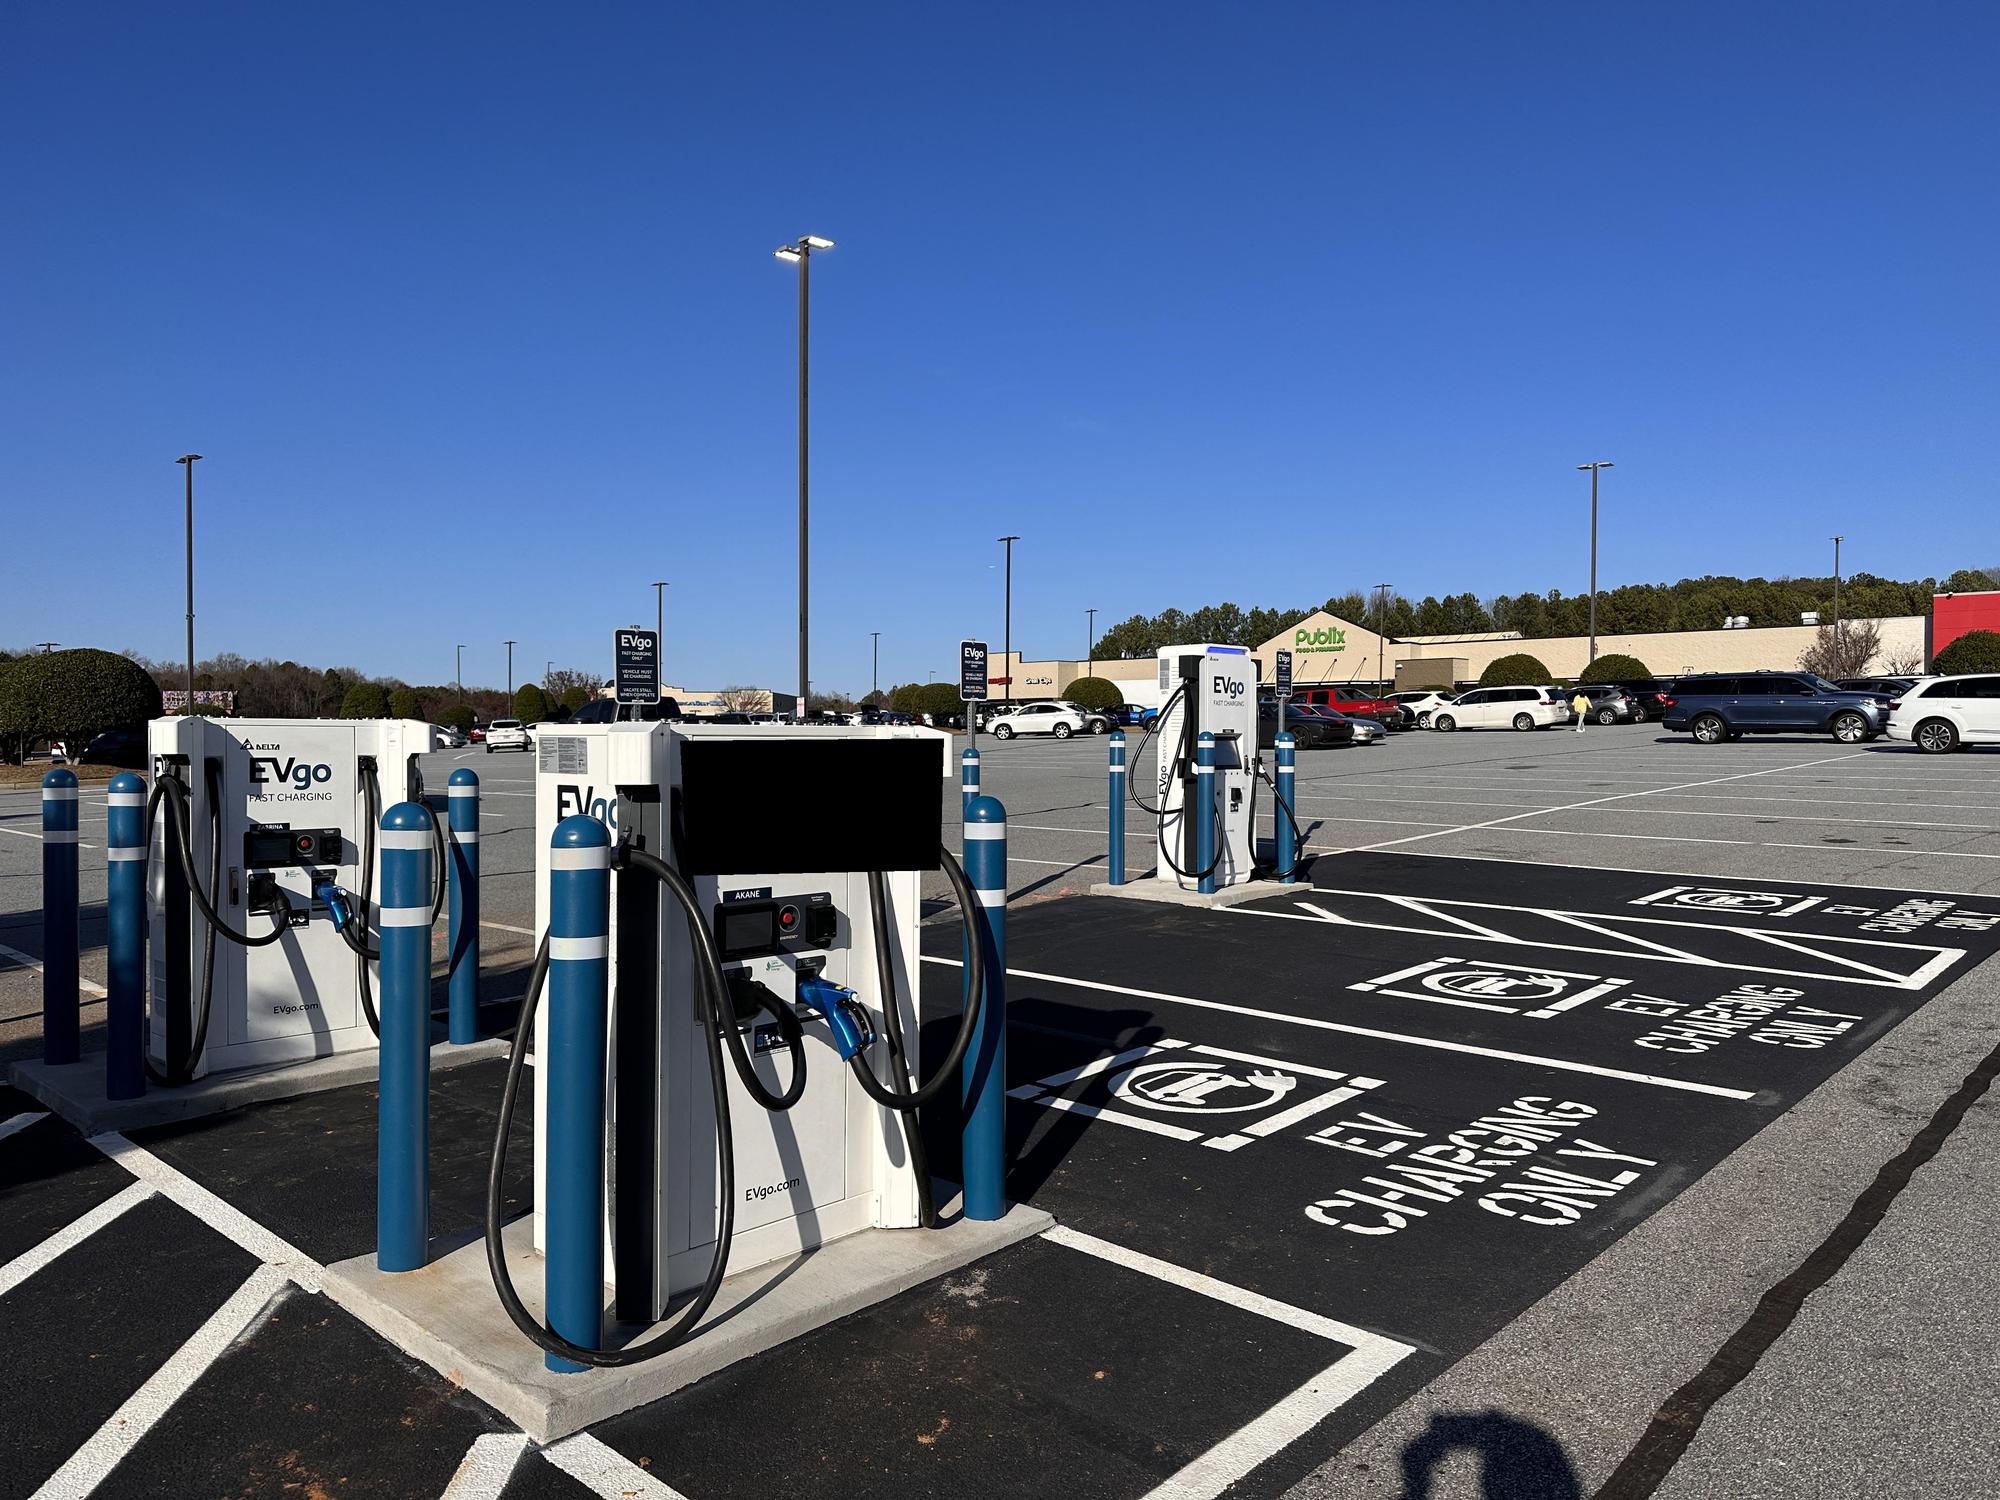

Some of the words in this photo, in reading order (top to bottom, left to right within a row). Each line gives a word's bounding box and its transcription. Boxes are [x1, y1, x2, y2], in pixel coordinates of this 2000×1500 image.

[621, 635, 652, 650] EVgo
[1296, 627, 1346, 646] Publix
[965, 648, 984, 660] EVgo
[1214, 676, 1244, 699] EVgo
[249, 757, 332, 790] EVgo
[249, 793, 275, 802] FAST
[277, 793, 332, 801] CHARGING
[735, 890, 760, 899] AKANE
[273, 1003, 318, 1014] EVgo.com
[1604, 993, 1689, 1017] EV
[1634, 984, 1804, 1053] CHARGING
[1749, 1006, 1863, 1049] ONLY
[1305, 1112, 1427, 1157] EV
[1305, 1096, 1598, 1235] CHARGING
[745, 1178, 800, 1201] EVgo.com
[1478, 1139, 1657, 1226] ONLY
